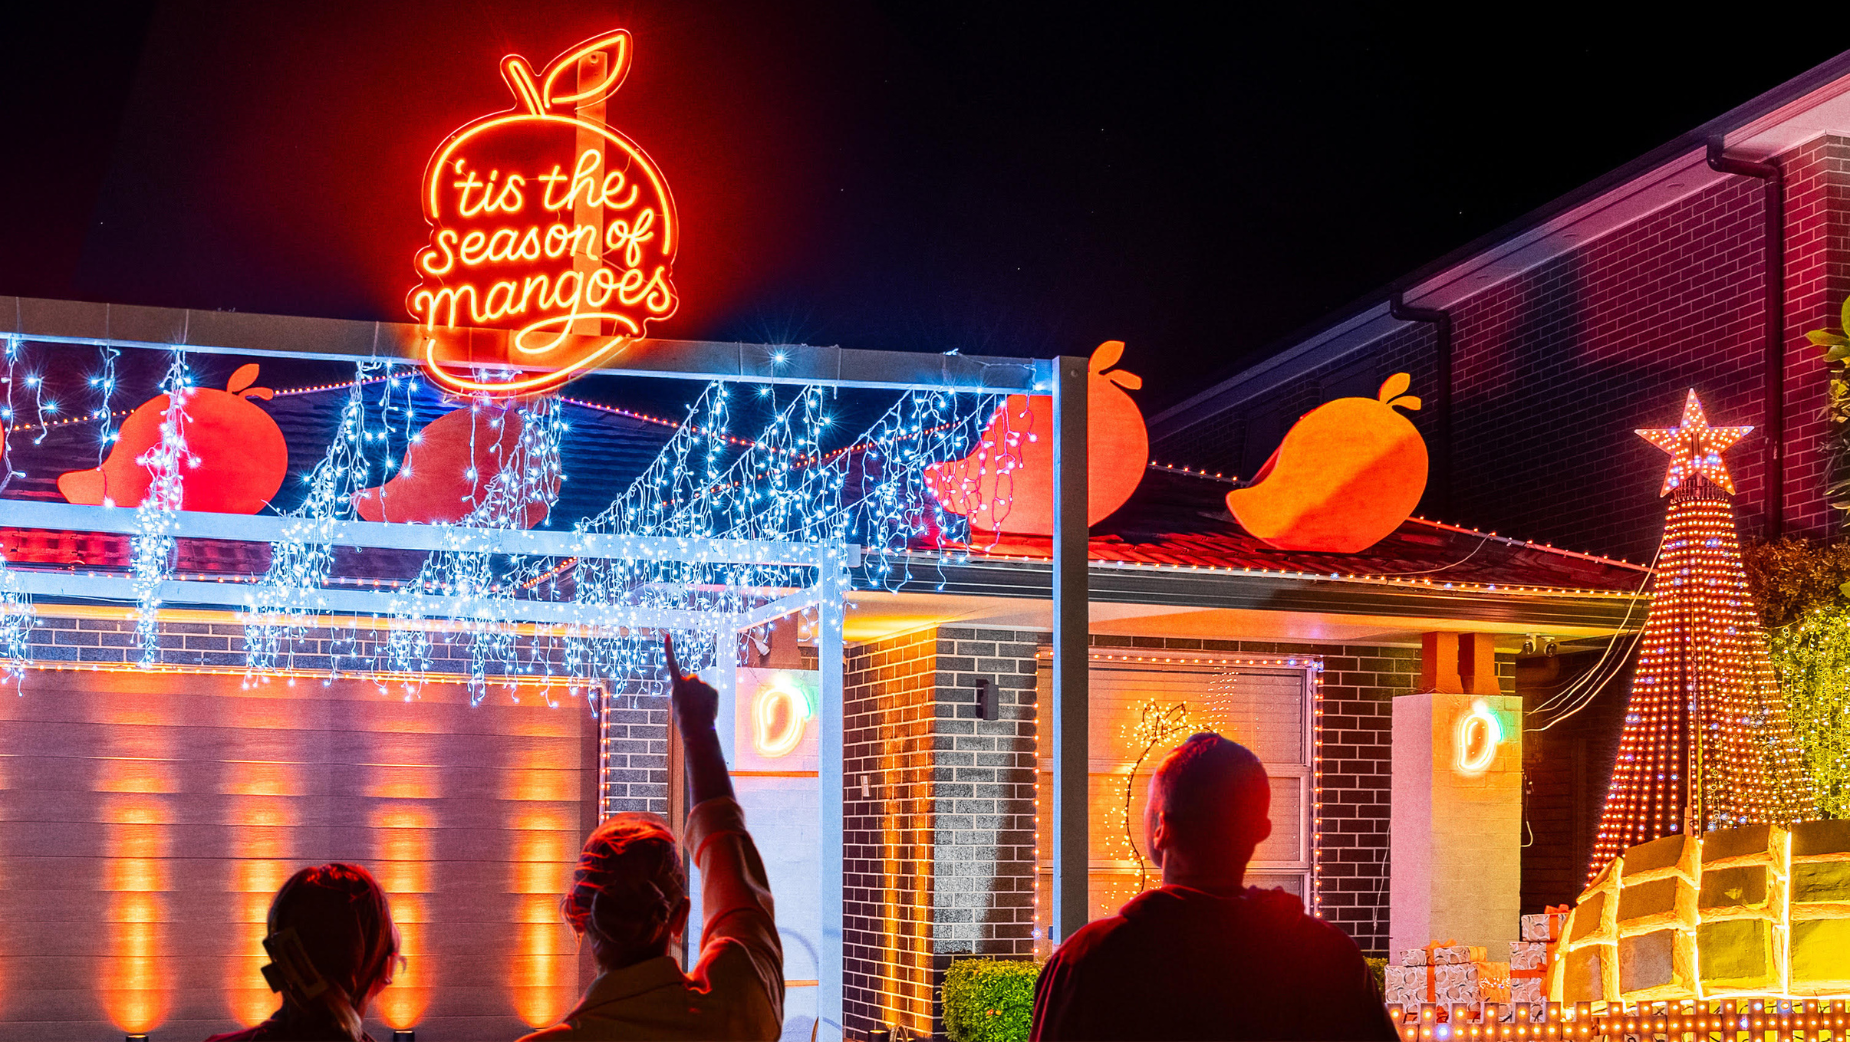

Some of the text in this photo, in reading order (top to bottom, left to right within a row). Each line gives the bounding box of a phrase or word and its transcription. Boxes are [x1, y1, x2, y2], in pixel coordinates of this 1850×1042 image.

[454, 149, 638, 217] 'tis the
[422, 208, 655, 274] season of
[414, 265, 672, 355] mangoes
